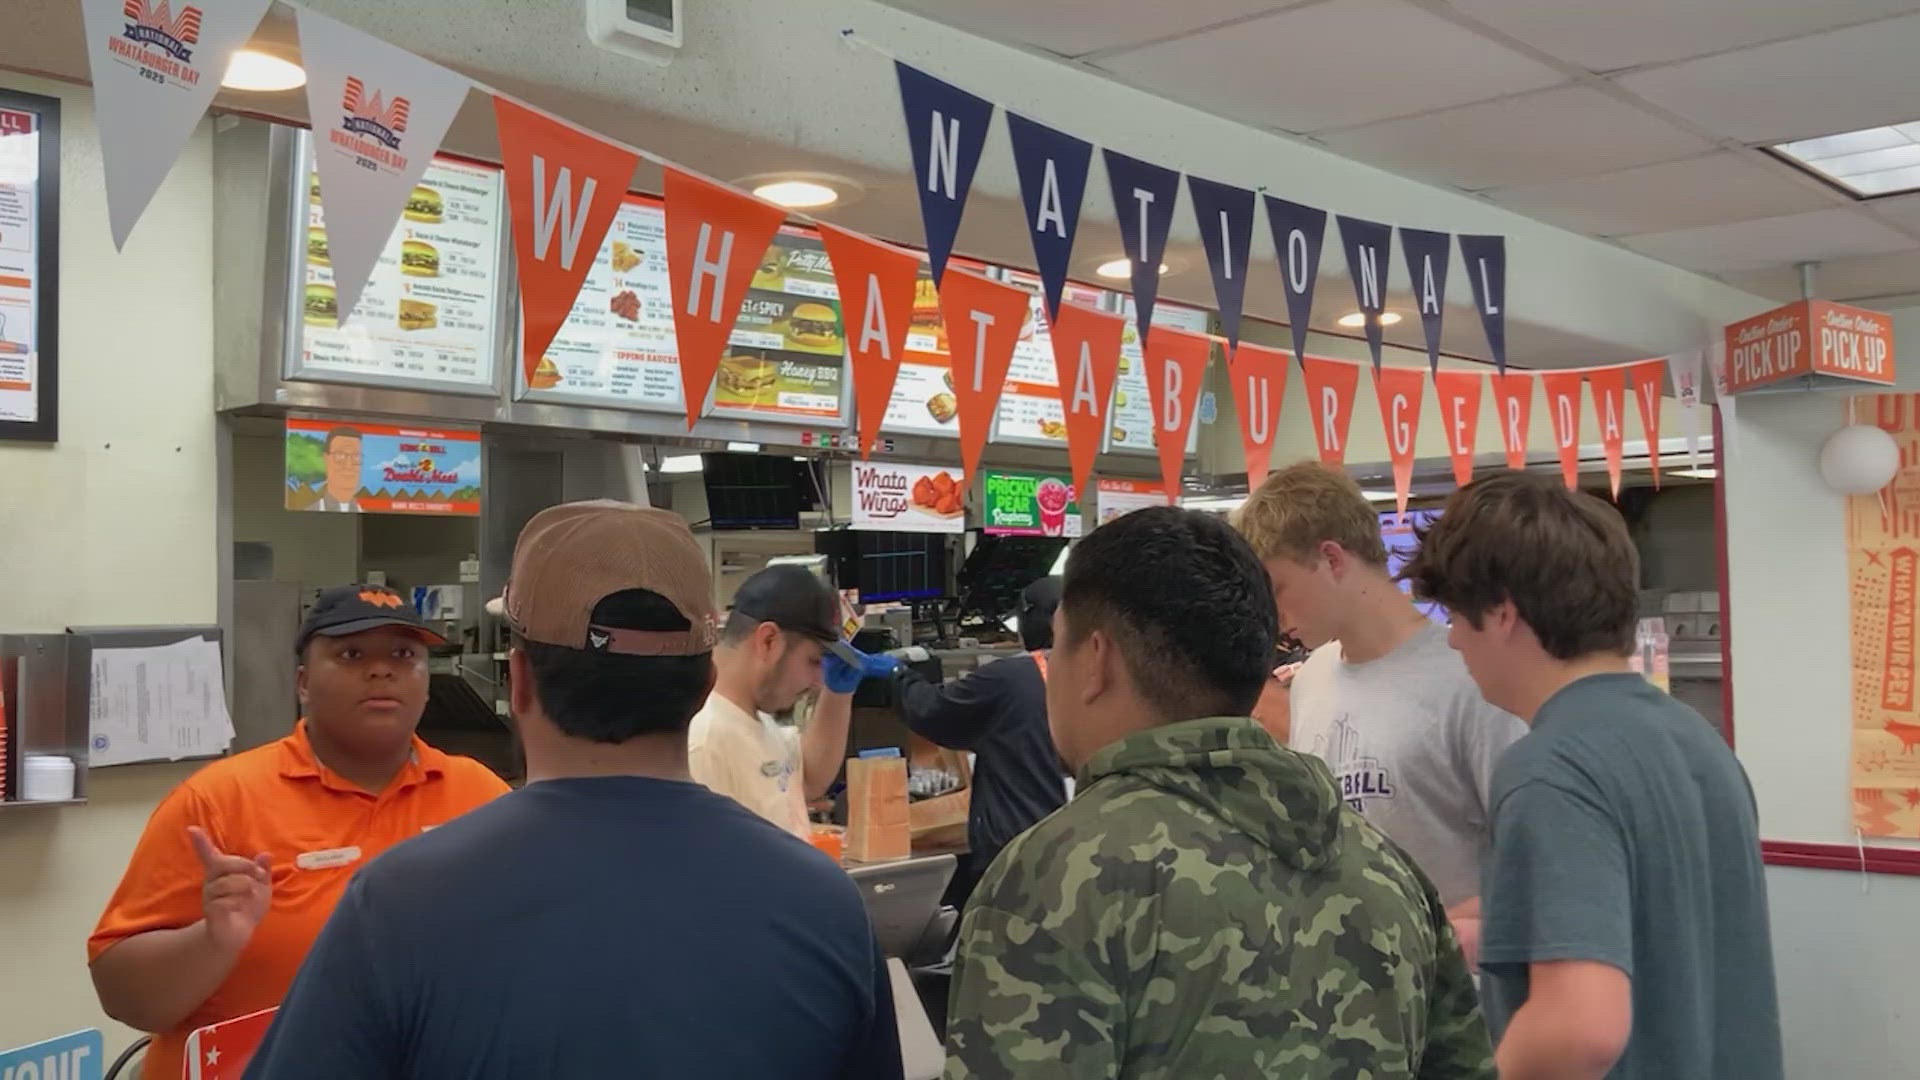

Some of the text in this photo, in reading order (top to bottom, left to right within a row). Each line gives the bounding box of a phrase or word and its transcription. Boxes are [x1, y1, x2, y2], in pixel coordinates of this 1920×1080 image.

[108, 36, 200, 85] WHATABURGER DAY
[140, 67, 165, 84] 2025
[356, 156, 377, 171] 2025
[928, 111, 1498, 315] NATIONAL
[787, 250, 815, 272] Patty
[613, 351, 645, 361] IPPING
[1733, 330, 1801, 385] PICK UP
[1821, 327, 1887, 375] PICK UP
[781, 360, 816, 383] Honey
[816, 366, 838, 381] BBQ
[1559, 382, 1659, 449] DAY
[855, 467, 907, 491] Whata
[987, 478, 1038, 497] PRICKLY
[860, 490, 908, 517] Wings
[996, 495, 1030, 512] PEAR
[1886, 556, 1912, 706] WHATABURGER
